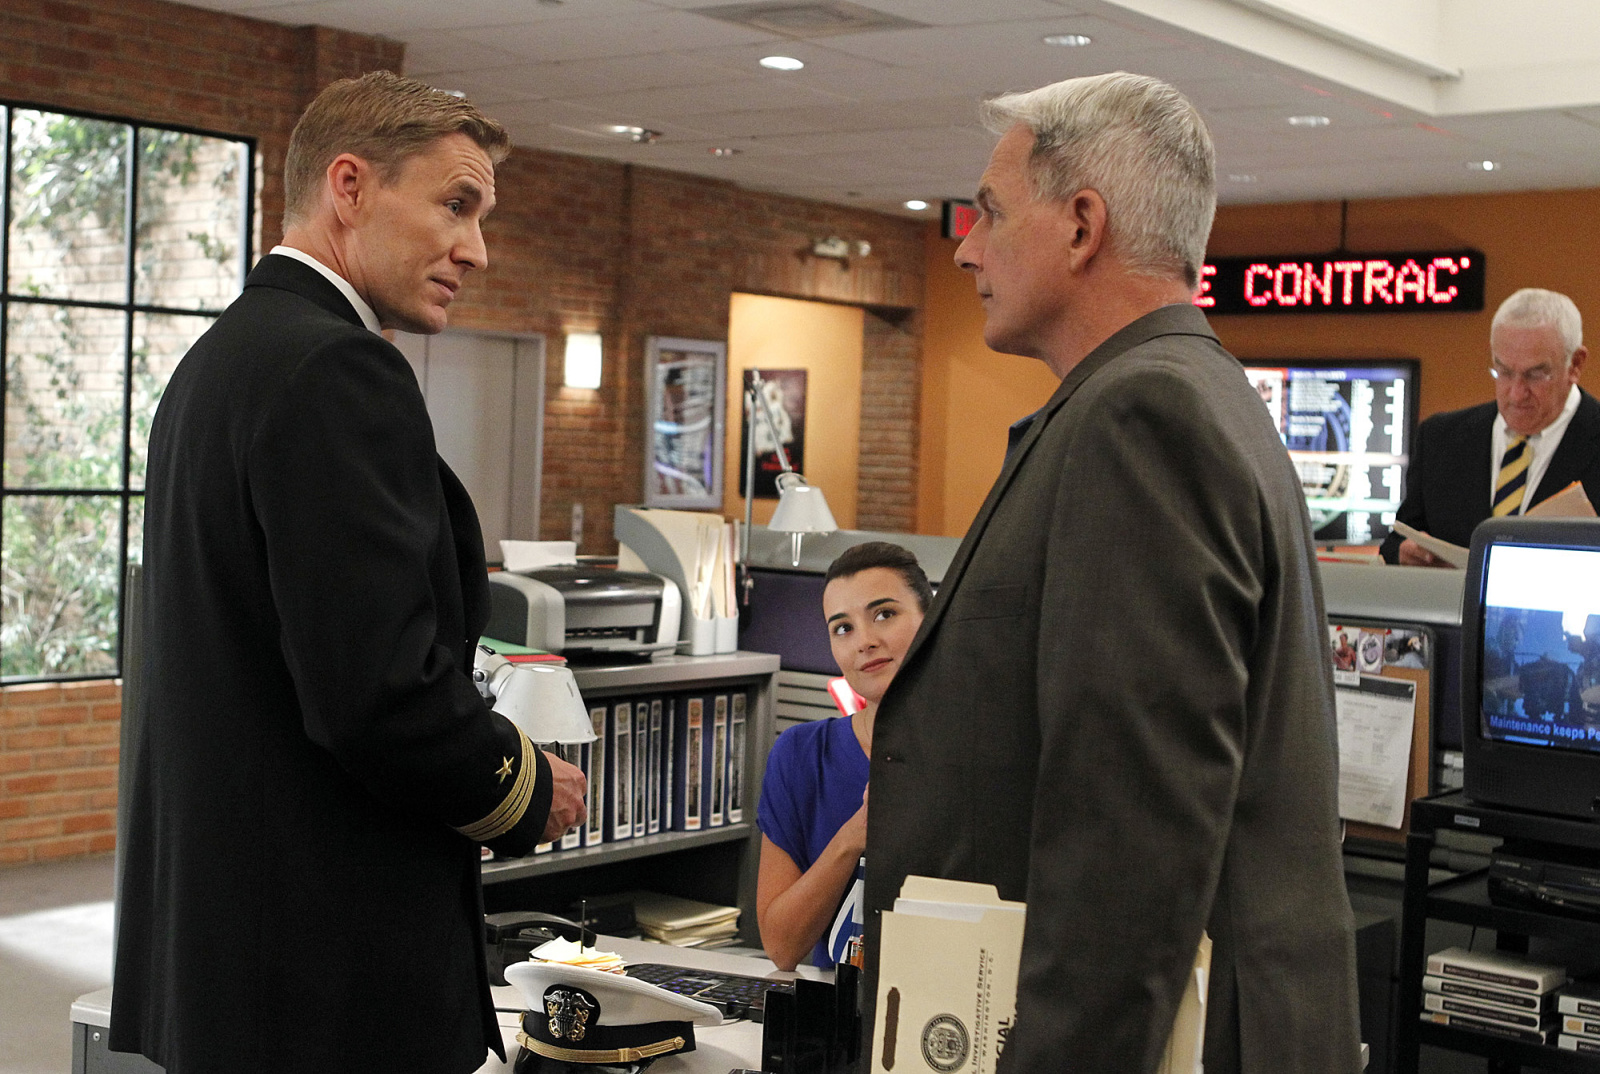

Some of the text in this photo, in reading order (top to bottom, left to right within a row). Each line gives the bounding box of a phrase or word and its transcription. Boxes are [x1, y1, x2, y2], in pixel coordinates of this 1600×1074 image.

[1245, 257, 1470, 306] CONTRAC
[1490, 715, 1551, 735] Maintenance
[1553, 723, 1585, 741] keeps
[976, 948, 986, 989] SERVICE
[971, 993, 982, 1066] INVESTIGATIVE
